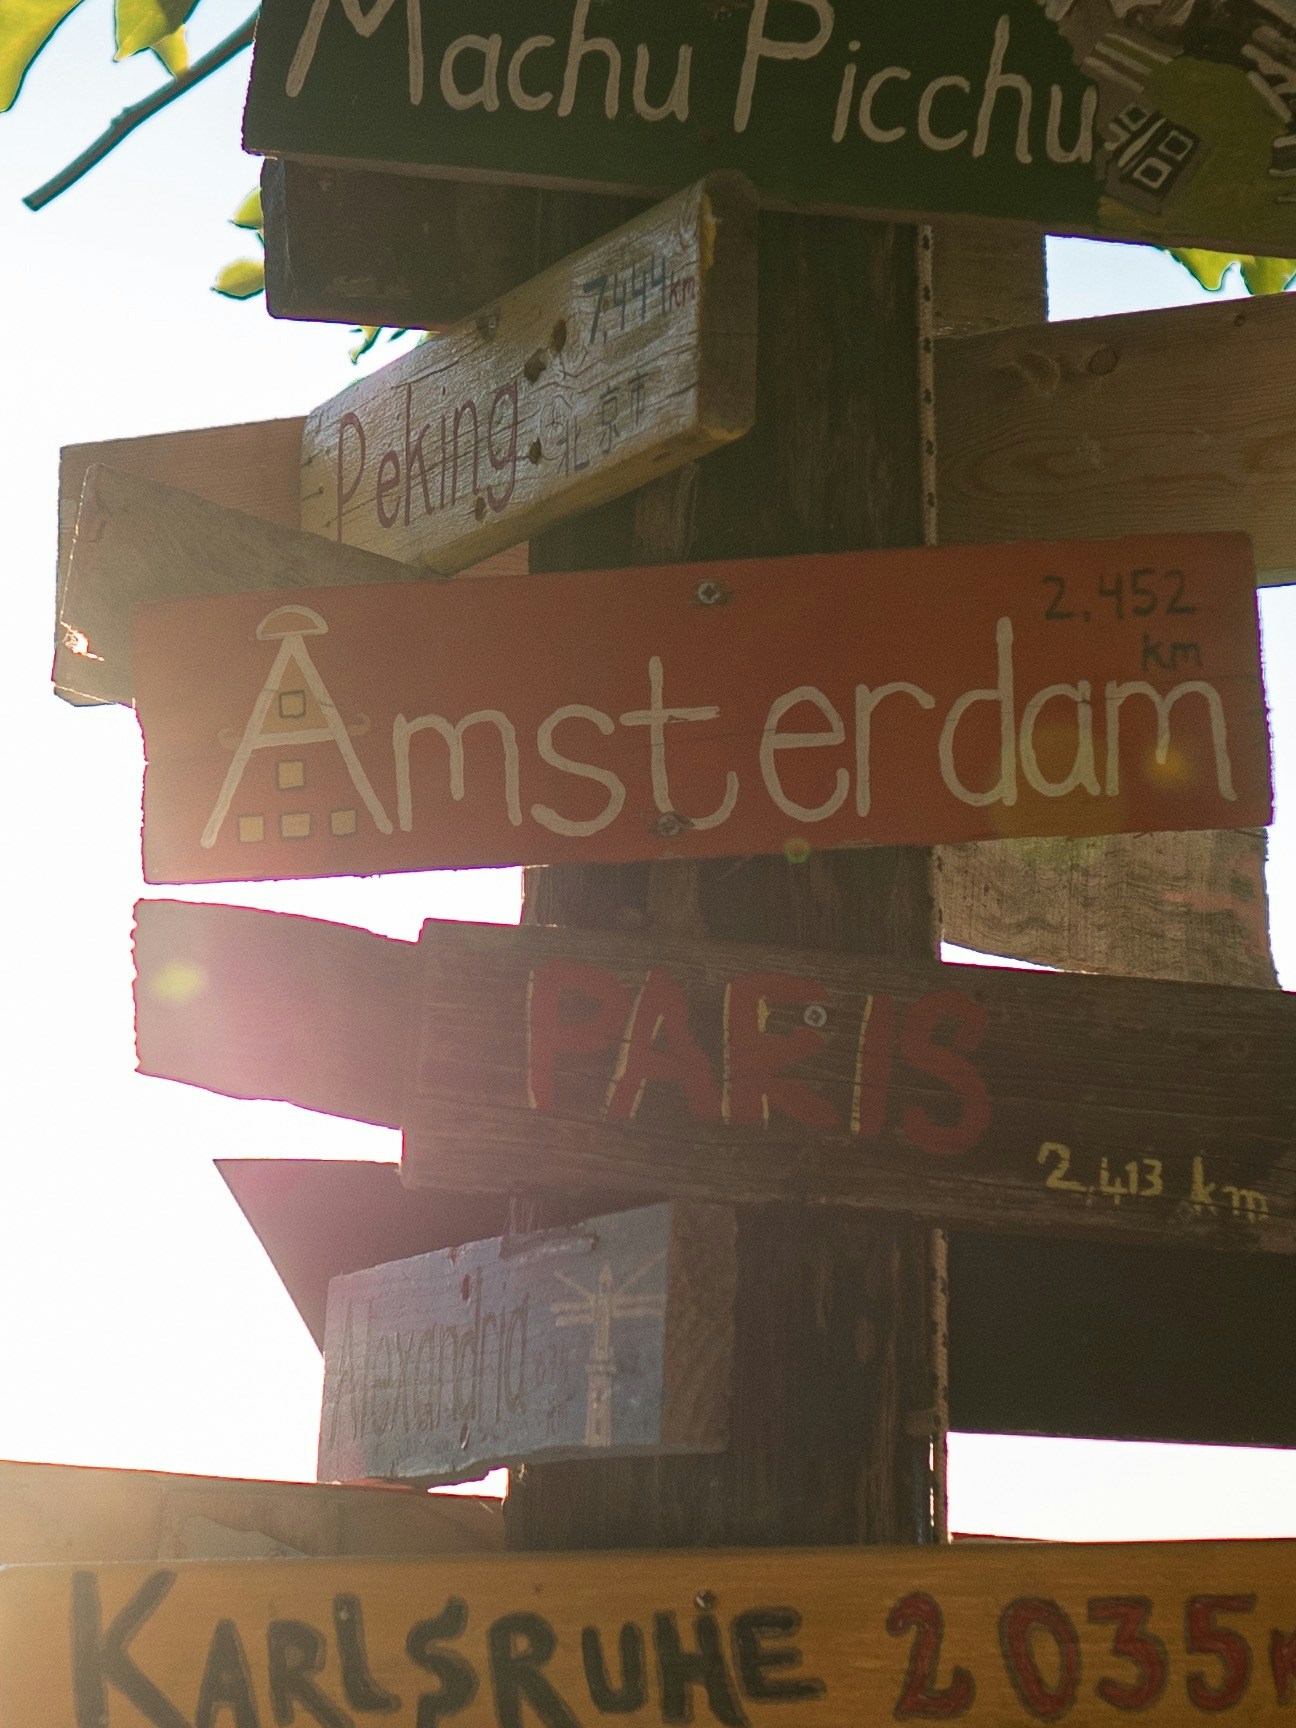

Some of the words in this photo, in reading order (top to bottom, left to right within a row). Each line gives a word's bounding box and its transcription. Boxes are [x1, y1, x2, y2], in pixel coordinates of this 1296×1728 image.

[336, 379, 520, 543] Peking
[200, 603, 1237, 848] Amsterdam
[525, 959, 993, 1157] PARIS
[1190, 1155, 1270, 1223] km
